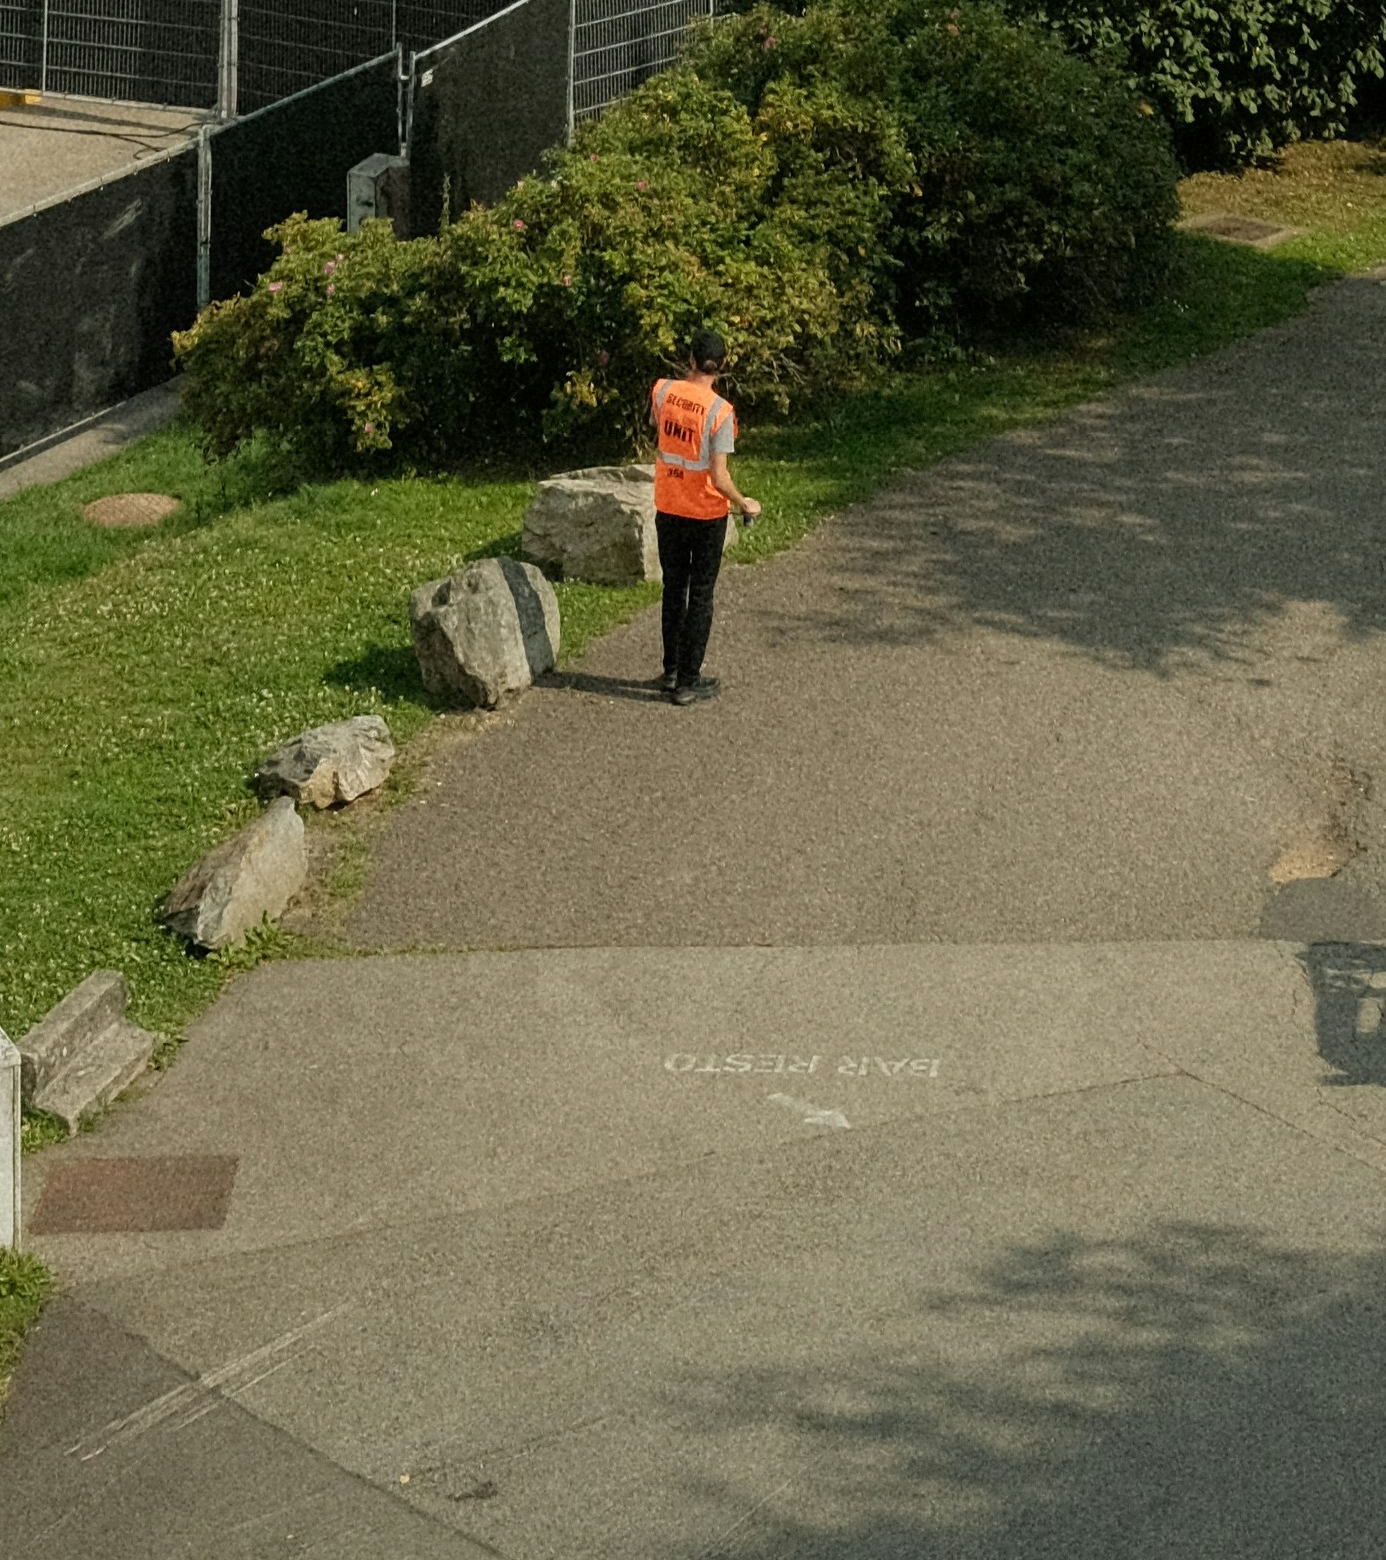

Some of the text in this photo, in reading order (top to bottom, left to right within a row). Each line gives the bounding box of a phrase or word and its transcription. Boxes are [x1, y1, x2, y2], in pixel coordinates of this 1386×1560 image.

[664, 420, 695, 445] UNIT
[664, 1054, 940, 1078] BAR RESTO
